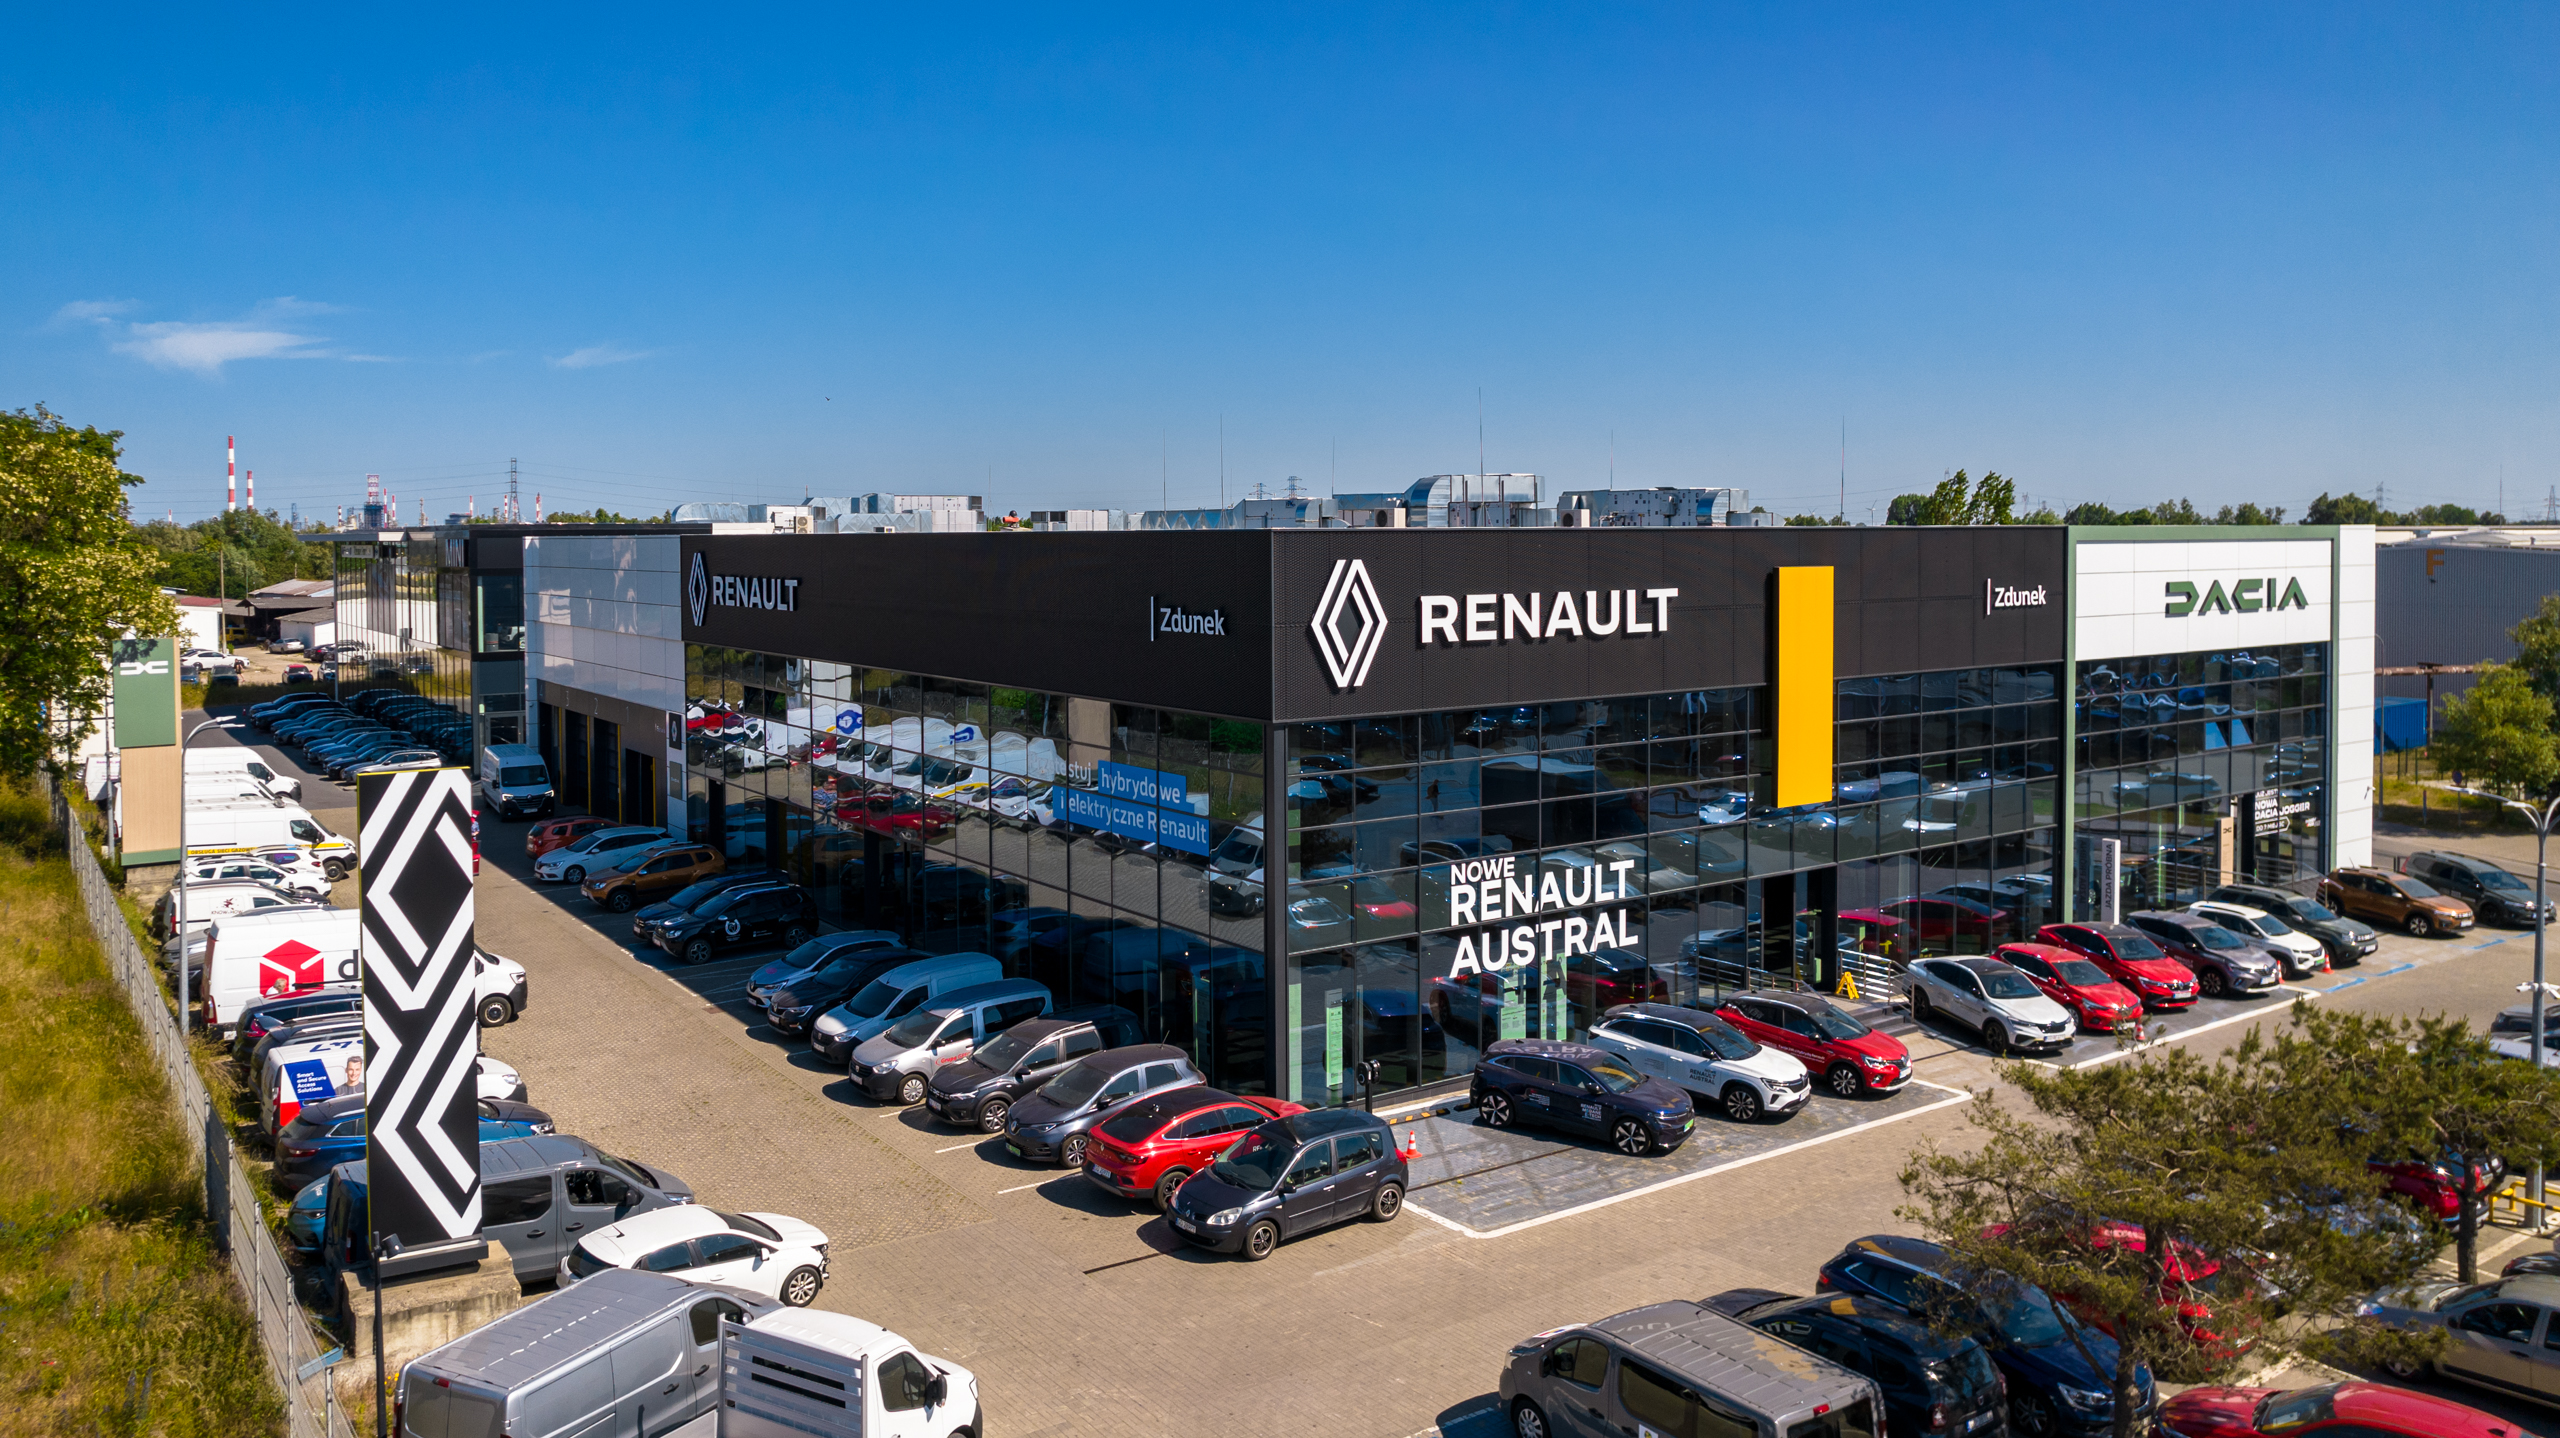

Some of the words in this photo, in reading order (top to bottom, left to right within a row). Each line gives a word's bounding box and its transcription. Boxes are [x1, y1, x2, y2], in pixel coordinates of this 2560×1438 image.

[2426, 549, 2445, 576] F
[712, 575, 798, 612] RENAULT
[1994, 584, 2047, 608] Zdunek
[2165, 576, 2309, 617] DACIA
[1160, 607, 1225, 636] Zdunek
[1420, 587, 1679, 644] RENAULT
[1101, 768, 1181, 804] hybrydowe
[1060, 790, 1065, 810] i
[1068, 793, 1144, 829] elektryczne
[1147, 810, 1207, 844] Renault
[2254, 808, 2278, 820] DACIA
[2279, 801, 2311, 816] JOGGER
[2255, 798, 2278, 810] NOWA
[1450, 856, 1516, 886] NOWE
[2105, 843, 2113, 880] PRÓBNA
[1450, 859, 1635, 927] RENAULT
[1449, 908, 1639, 979] AUSTRAL
[297, 1081, 316, 1089] Access
[297, 1086, 323, 1094] Solutions
